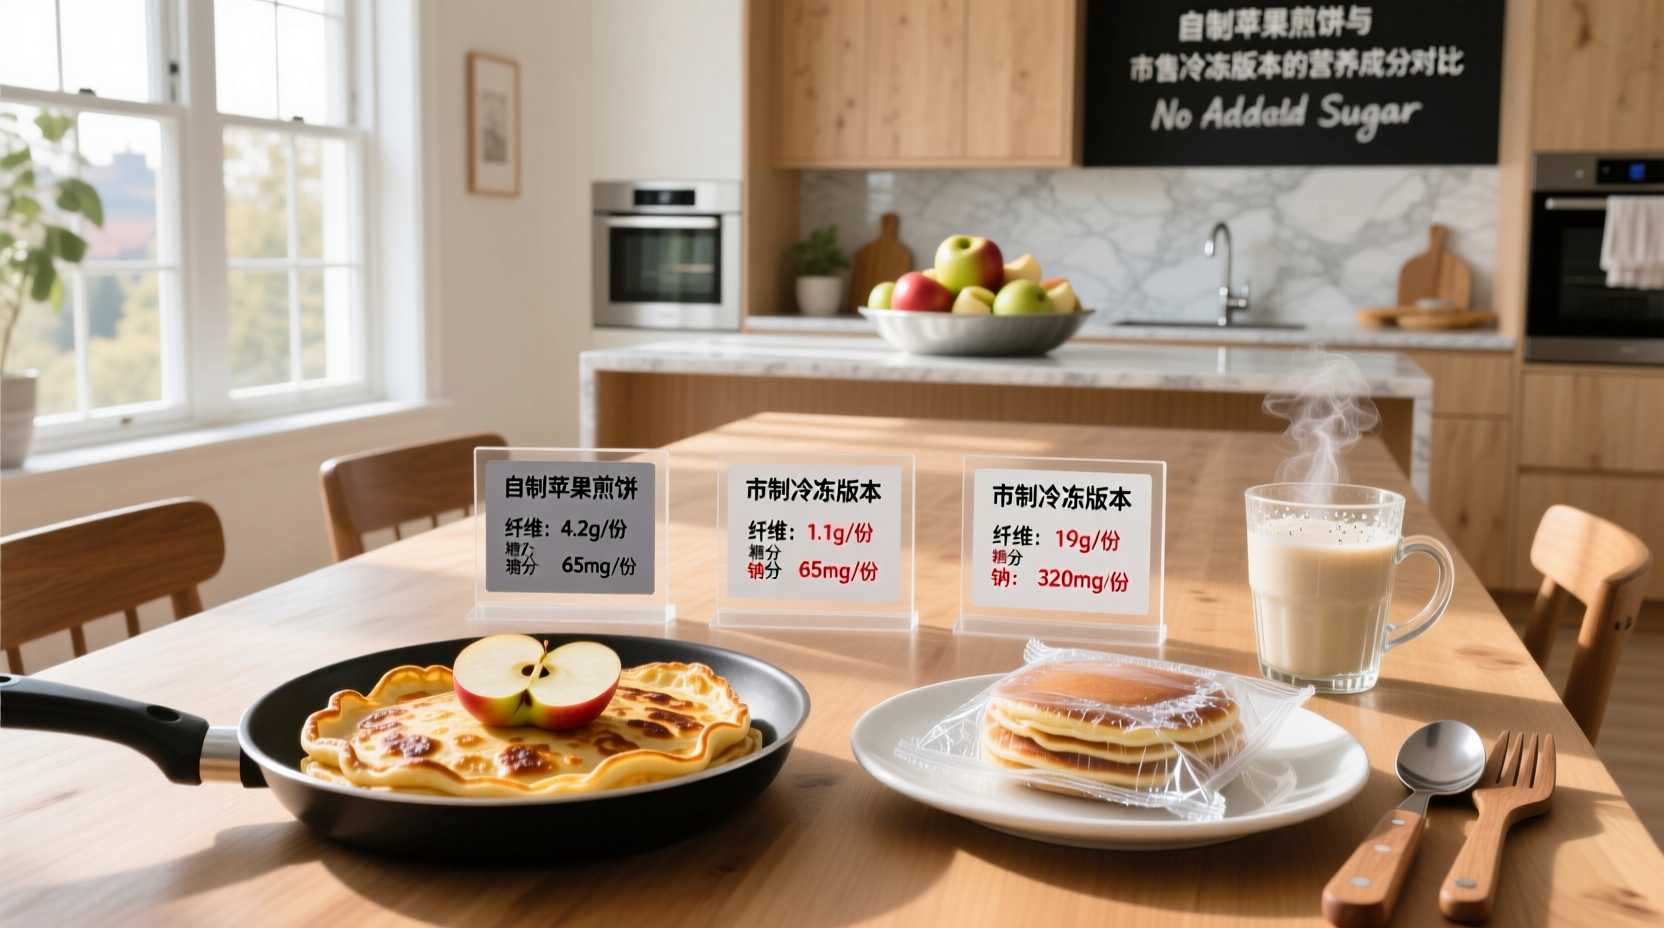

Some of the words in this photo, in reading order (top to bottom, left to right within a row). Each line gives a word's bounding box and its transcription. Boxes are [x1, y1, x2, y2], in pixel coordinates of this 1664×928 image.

[1178, 5, 1373, 42] 自制苹果煎饼与
[1129, 45, 1465, 83] 市售冷冻版本的营养成分对比
[1150, 97, 1192, 131] No
[1317, 92, 1423, 144] Sugar
[505, 475, 638, 500] 自制苹果煎饼
[746, 477, 881, 503] 市制冷冻版本
[992, 483, 1132, 511] 市制冷冻版本
[561, 518, 628, 542] 4.2g/份
[808, 522, 874, 546] 1.1g/份
[1056, 529, 1121, 553] 19g/份
[562, 556, 637, 579] 65mg/份
[799, 560, 879, 584] 65mg/份
[1037, 569, 1129, 594] 320mg/份
